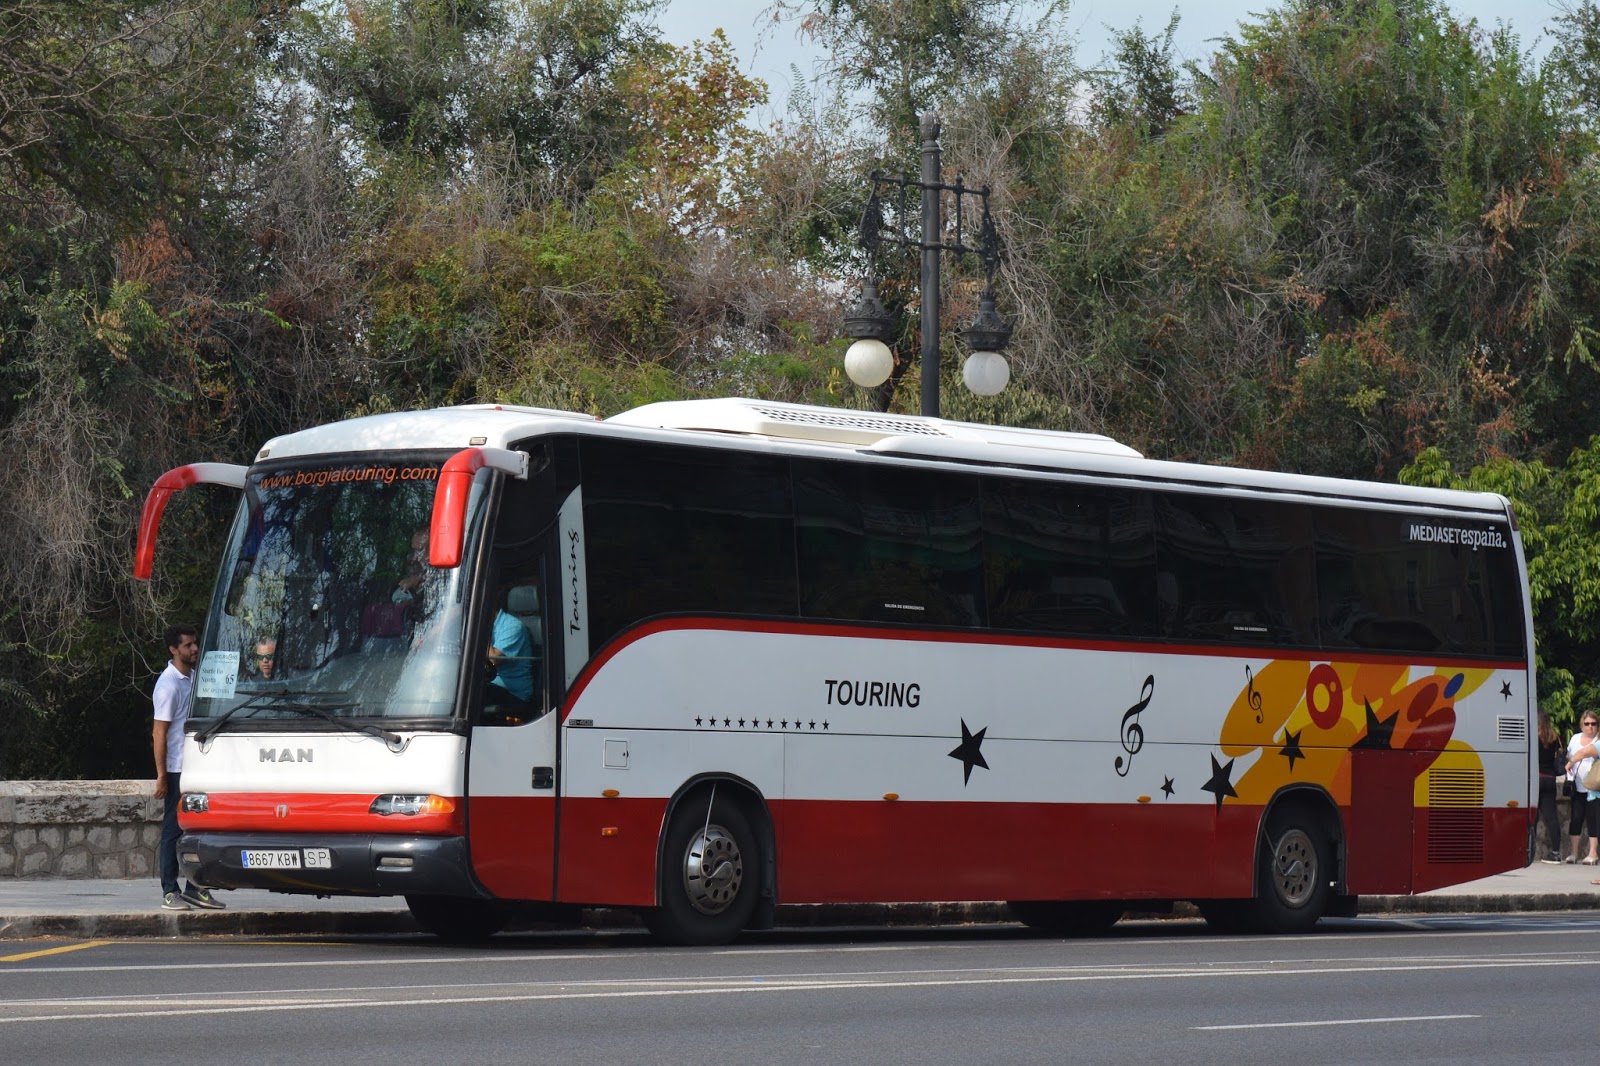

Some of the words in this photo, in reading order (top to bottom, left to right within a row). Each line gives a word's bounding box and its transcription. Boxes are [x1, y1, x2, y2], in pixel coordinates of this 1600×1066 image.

[259, 465, 438, 490] www.borgiatouring.com
[568, 528, 580, 636] Touring
[225, 673, 235, 685] 65
[824, 679, 921, 708] TOURING
[259, 748, 313, 763] MAN
[248, 852, 274, 866] 8667
[277, 852, 298, 866] KBW
[307, 851, 327, 866] SP
